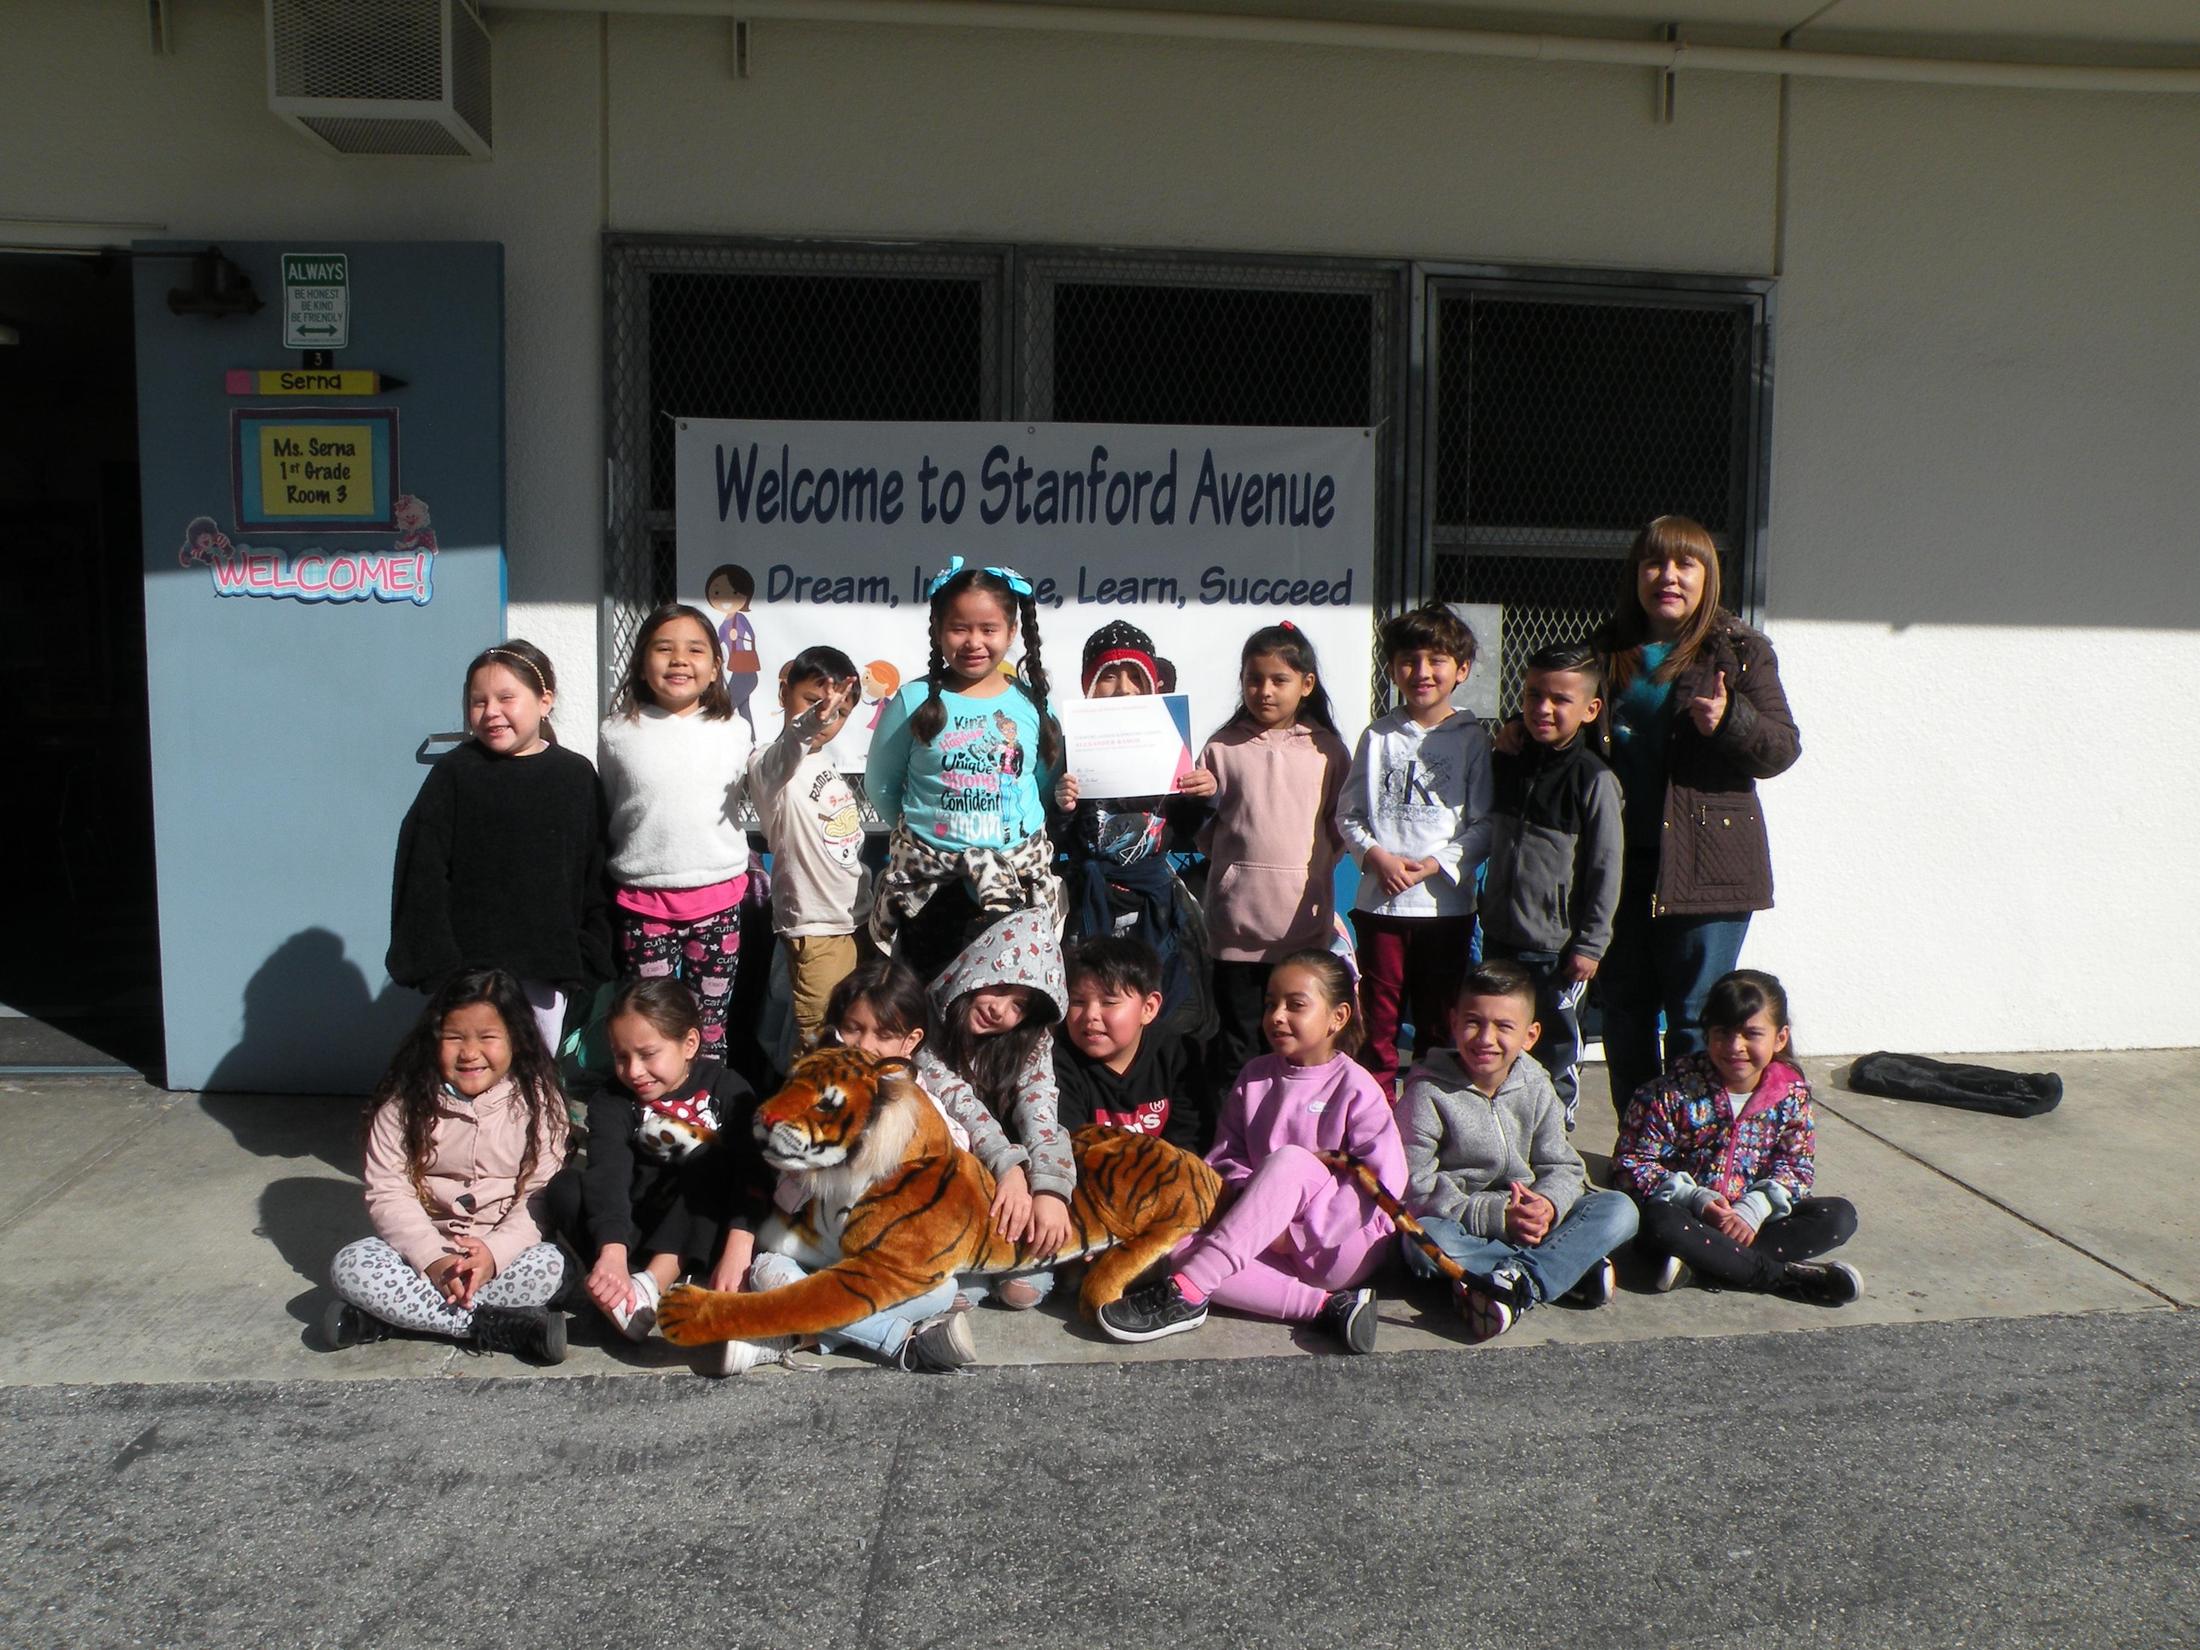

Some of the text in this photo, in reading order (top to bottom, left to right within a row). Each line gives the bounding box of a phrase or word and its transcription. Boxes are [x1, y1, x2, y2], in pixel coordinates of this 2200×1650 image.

[287, 262, 345, 281] ALWAYS
[294, 289, 339, 300] BE HONEST
[301, 301, 334, 311] BE KIND
[290, 312, 344, 322] BE FRIENDLY
[313, 351, 323, 367] 3
[280, 372, 342, 390] Serna
[273, 437, 356, 457] Ms. Serna
[304, 461, 351, 480] Grade
[286, 484, 348, 504] Room 3
[715, 442, 1336, 529] Welcome to Stanford Avenue
[211, 551, 426, 599] WELCOME!
[766, 563, 900, 609] Dream,
[1077, 565, 1186, 609] Learn,
[1198, 565, 1353, 606] Succeed
[953, 714, 987, 730] Kind
[940, 788, 1001, 813] Confident
[713, 924, 735, 933] cute
[643, 937, 668, 949] cute
